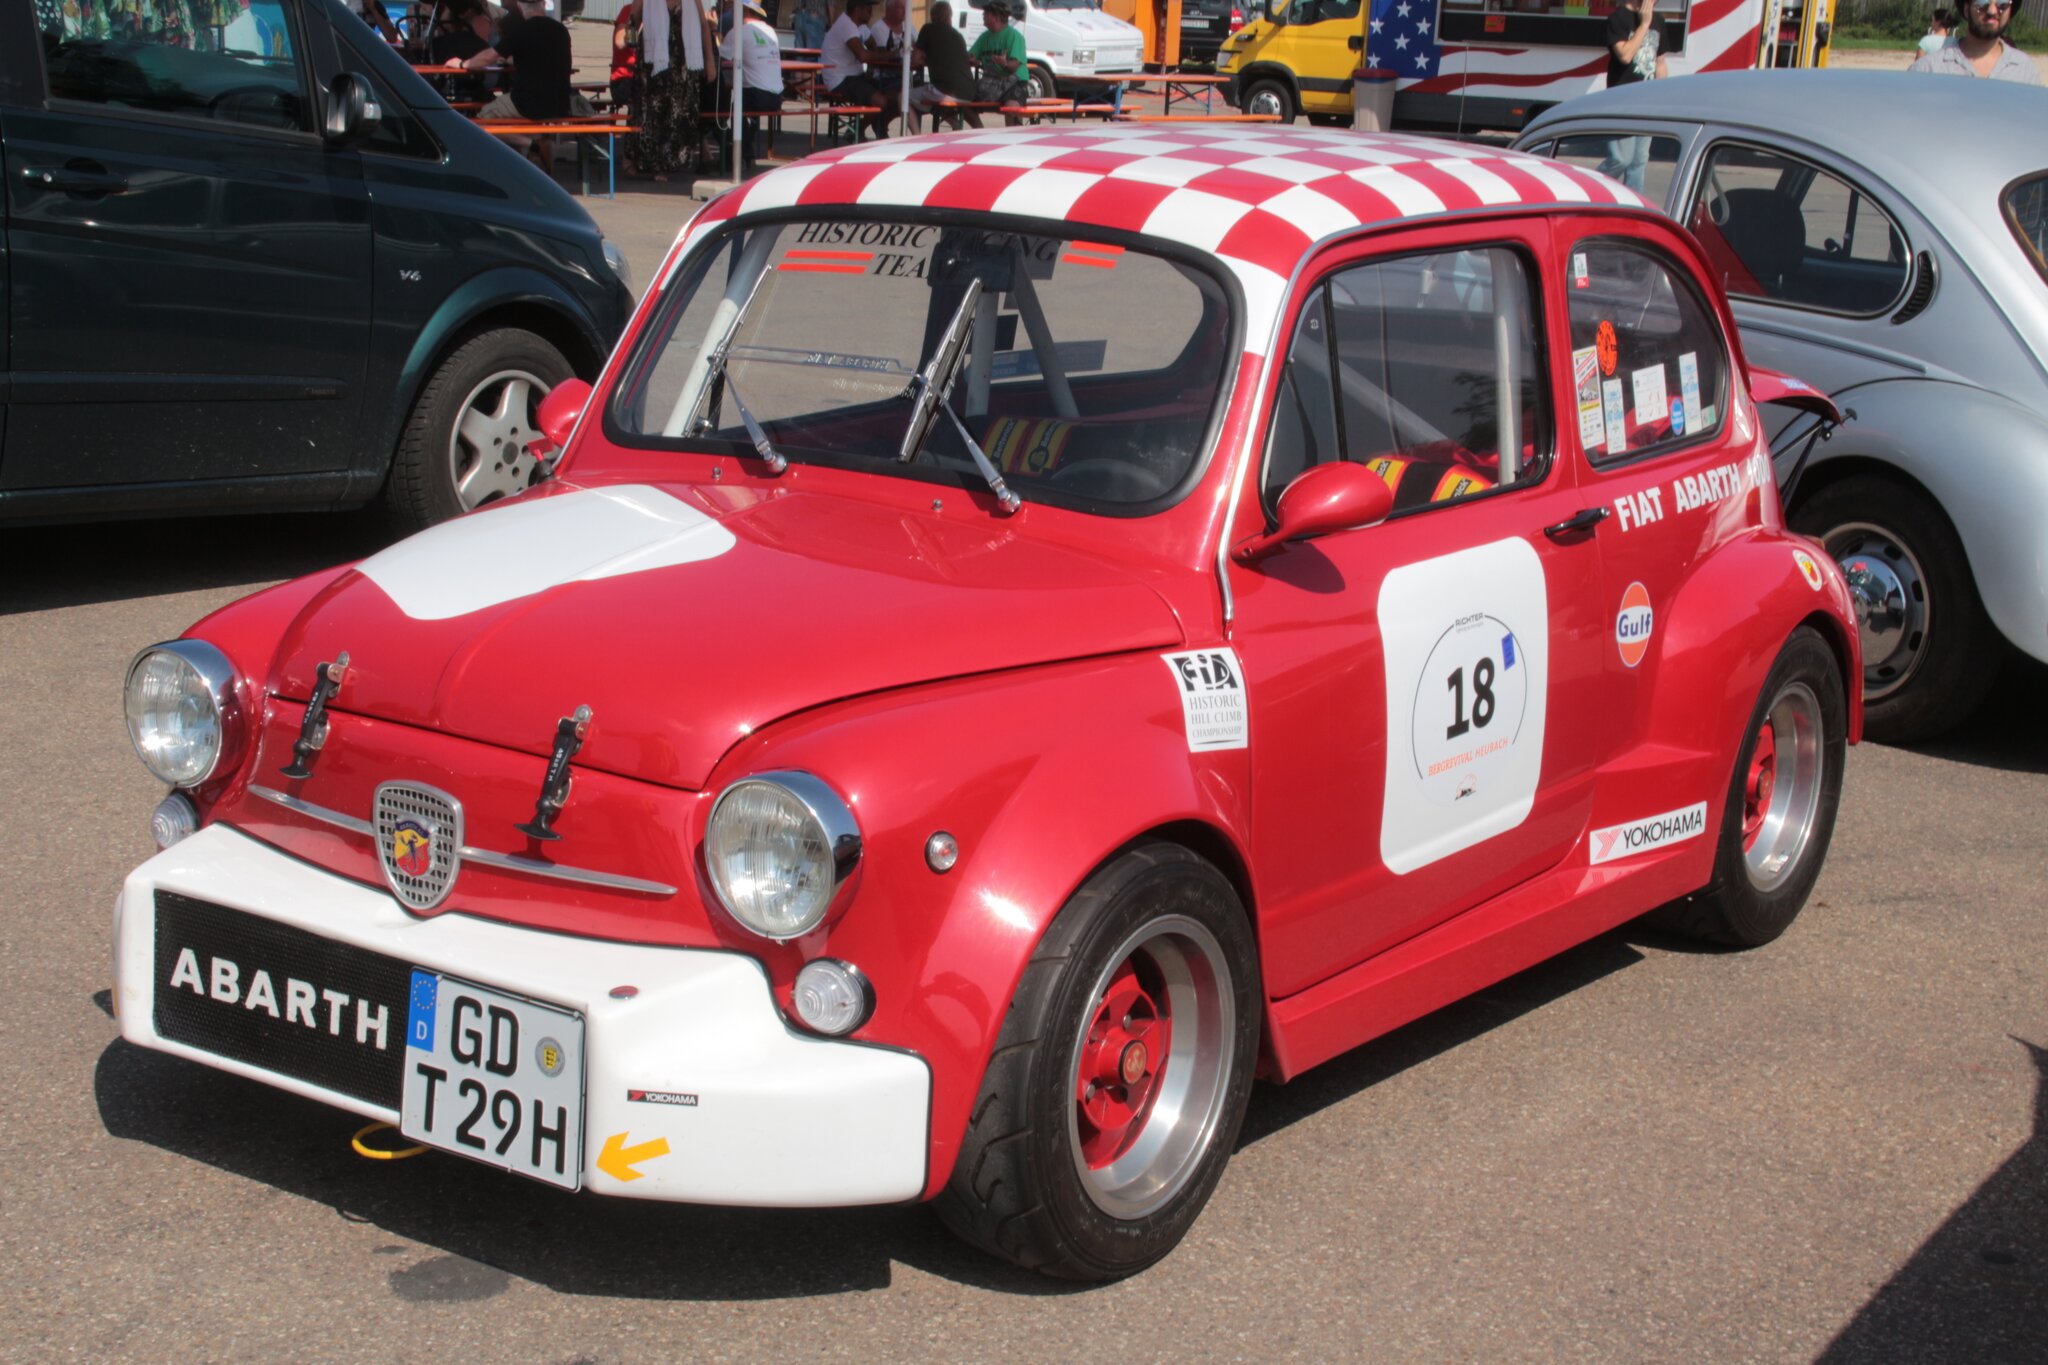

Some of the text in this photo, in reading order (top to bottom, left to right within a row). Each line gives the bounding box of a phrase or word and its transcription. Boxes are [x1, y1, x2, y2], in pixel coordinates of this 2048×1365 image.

[796, 222, 938, 249] HISTORIC
[399, 269, 422, 281] V6
[1614, 486, 1664, 532] FIAT
[1673, 462, 1742, 514] ABARTH
[1618, 612, 1651, 638] Gulf
[1188, 694, 1242, 711] HISTORIC
[1446, 656, 1496, 741] 18
[1191, 710, 1243, 726] HILL CLIMB
[1192, 725, 1243, 738] CHAMPIONSHIP
[1428, 737, 1510, 777] BERGREVIVAL HEUBACH
[1622, 808, 1703, 849] YOKOHAMA
[169, 947, 389, 1050] ABARTH
[415, 1020, 428, 1041] D
[450, 994, 520, 1078] GD
[644, 1092, 697, 1105] YOKOHAMA
